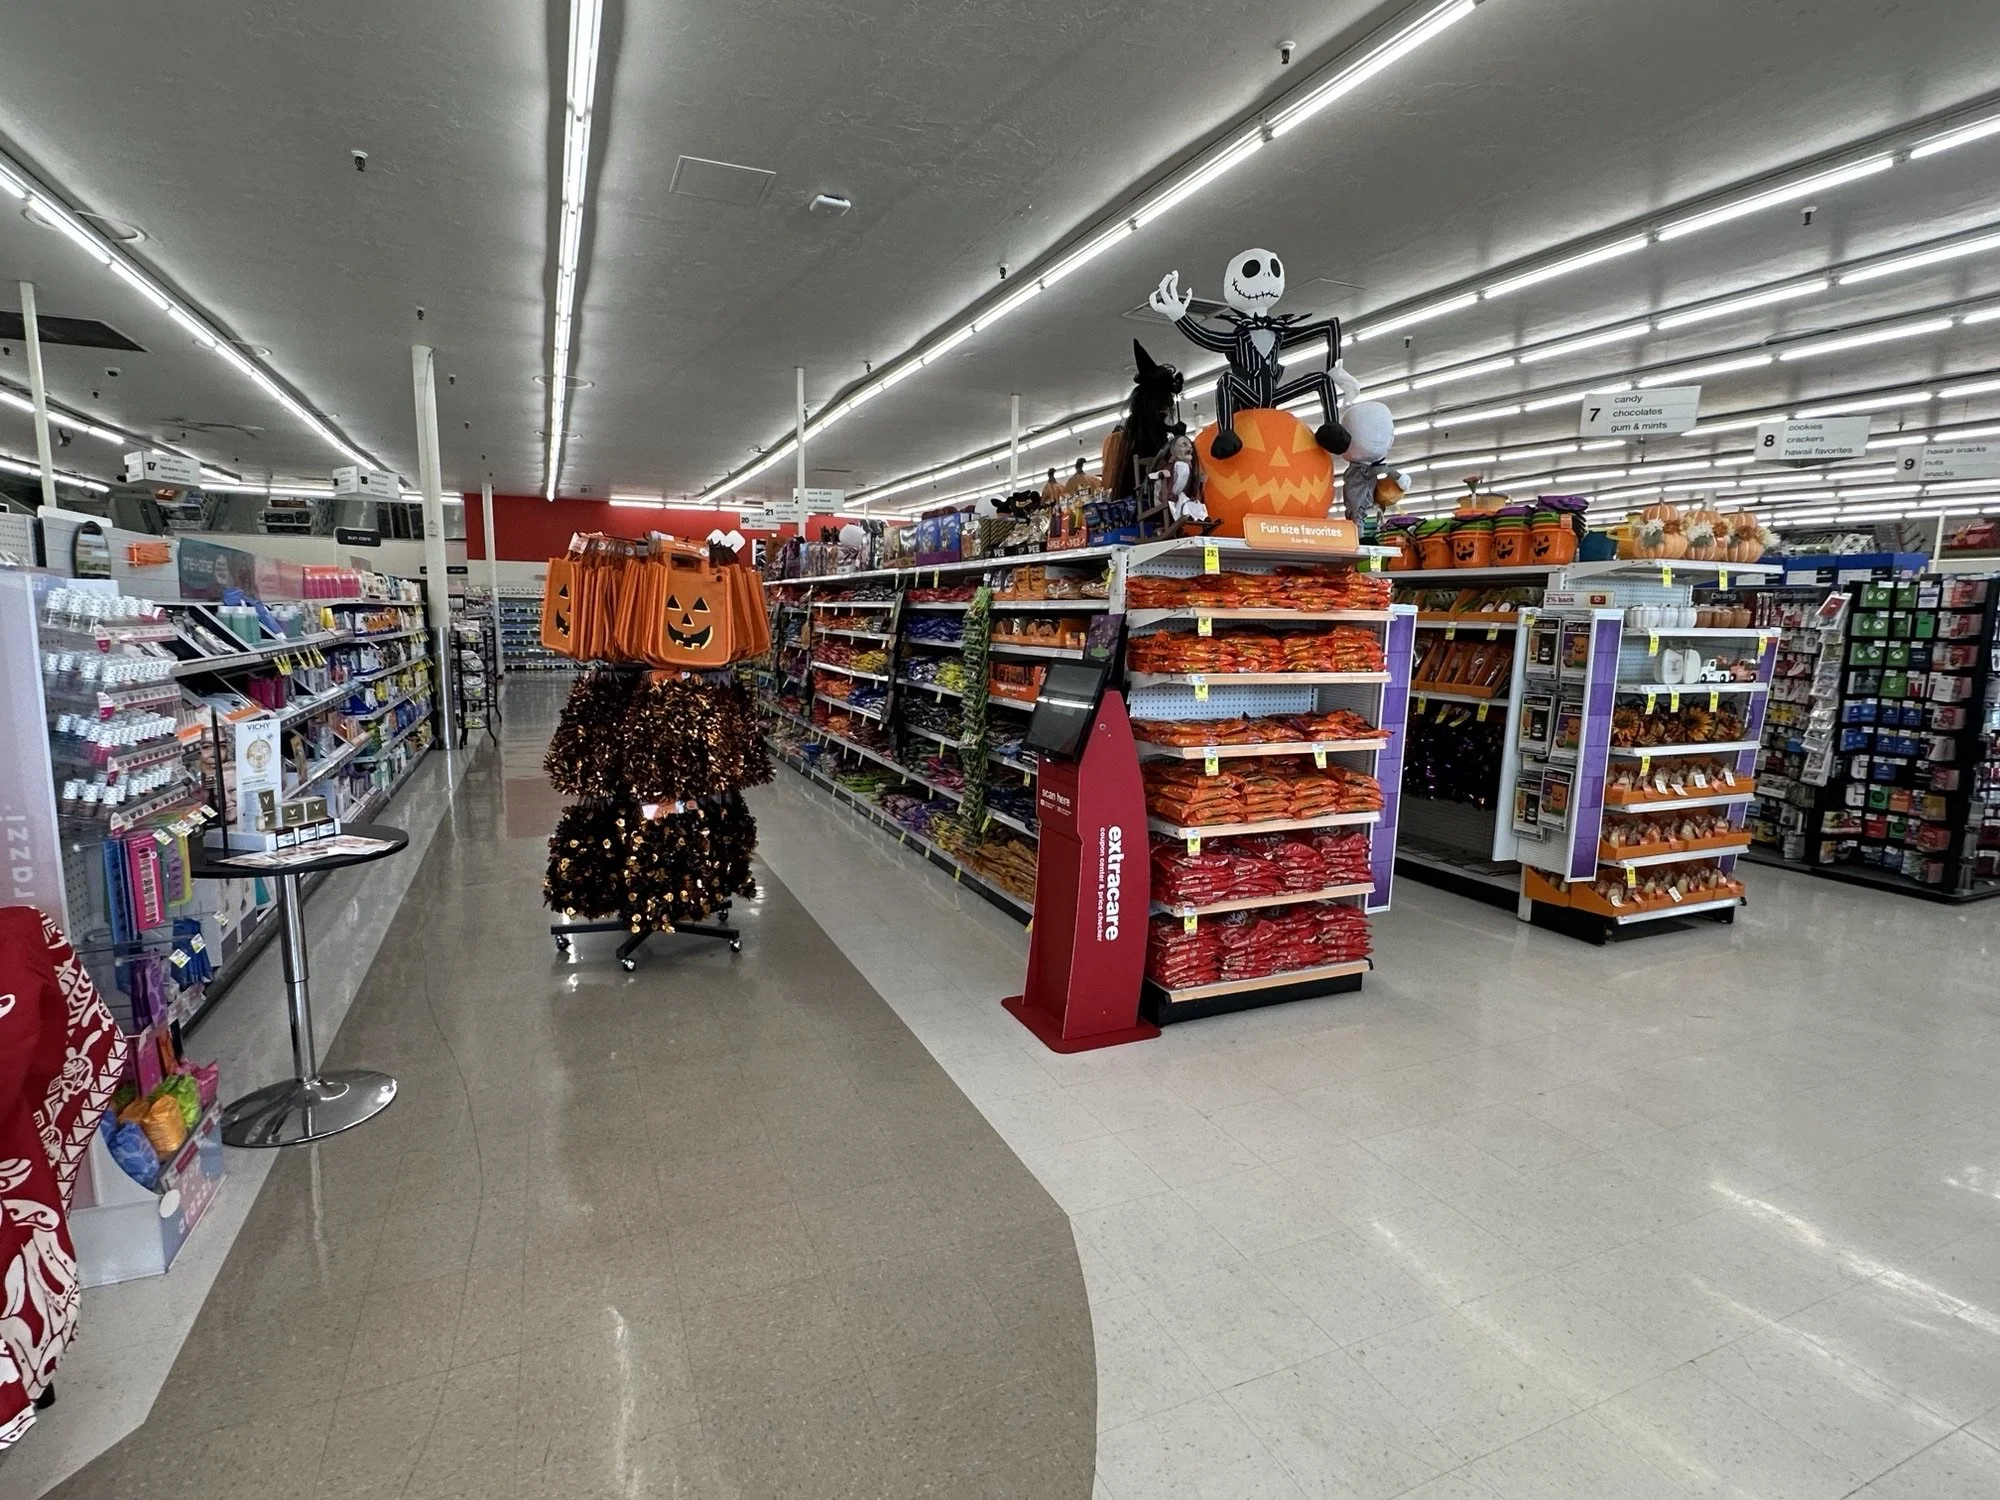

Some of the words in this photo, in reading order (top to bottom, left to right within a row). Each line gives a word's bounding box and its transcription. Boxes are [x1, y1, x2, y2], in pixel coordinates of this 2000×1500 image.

[1614, 395, 1643, 404] candy
[1589, 408, 1601, 422] 7
[1612, 408, 1663, 418] chocolates
[1610, 423, 1631, 433] gum
[1633, 422, 1640, 431] &
[1641, 421, 1668, 430] mints
[1788, 423, 1823, 432] cookies
[1763, 434, 1775, 448] 8
[1786, 435, 1825, 444] crackers
[1784, 448, 1813, 456] hawaii
[1814, 447, 1854, 455] favorites
[1926, 447, 1954, 455] hawaii
[1955, 445, 1987, 454] snacks
[1903, 458, 1915, 470] 9
[764, 508, 774, 516] 21
[1260, 522, 1280, 534] Fun
[1281, 523, 1300, 535] size
[1301, 524, 1343, 538] favorites
[1711, 592, 1737, 601] Dining
[246, 722, 271, 731] VICHY
[1041, 788, 1056, 801] scan
[1056, 791, 1071, 807] here
[1105, 826, 1125, 941] extracare
[1097, 891, 1105, 911] price
[1096, 911, 1104, 942] checker
